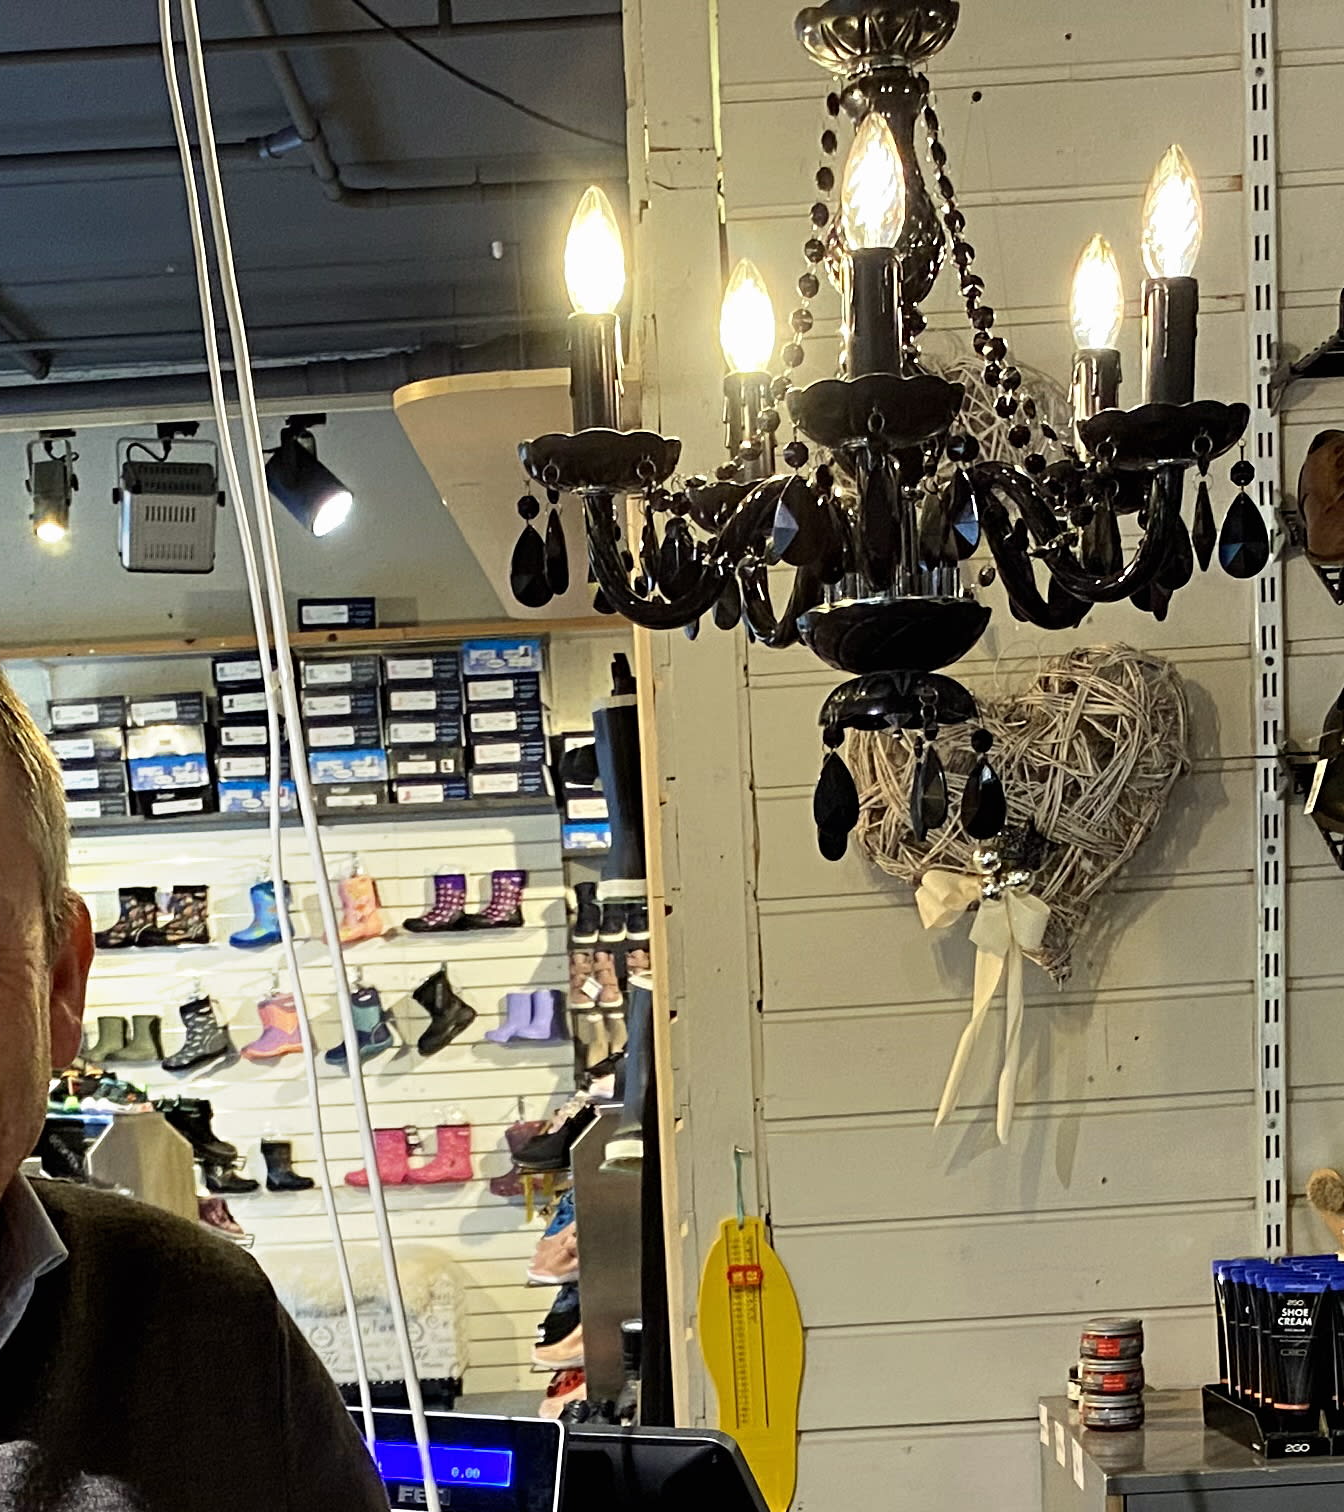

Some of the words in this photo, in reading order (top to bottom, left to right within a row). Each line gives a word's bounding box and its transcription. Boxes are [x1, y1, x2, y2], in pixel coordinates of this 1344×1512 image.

[1281, 1308, 1309, 1317] SHOE
[1277, 1317, 1313, 1326] CREAM
[1284, 1443, 1311, 1453] 2GO
[398, 1485, 448, 1505] FE
